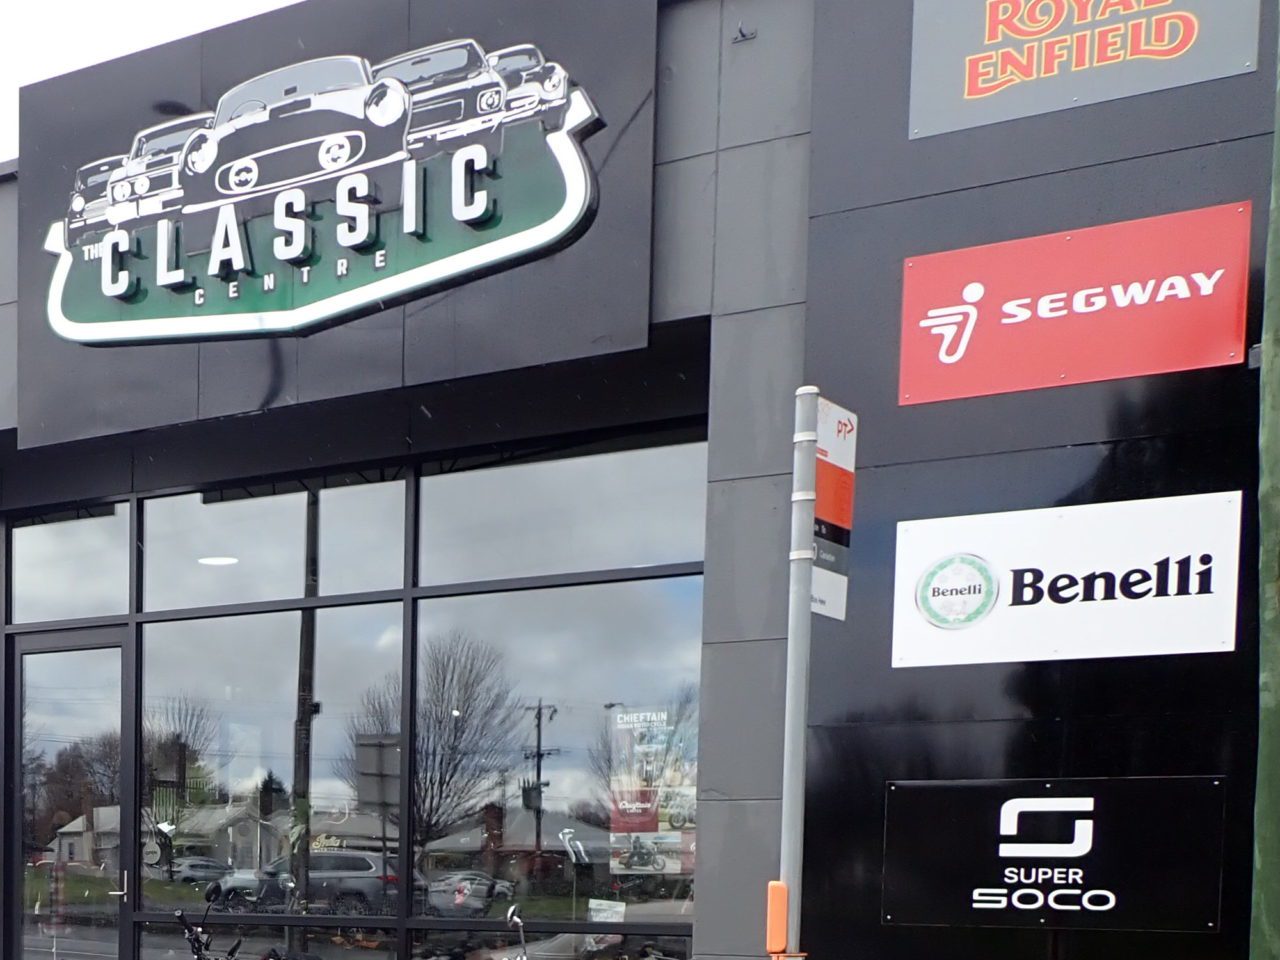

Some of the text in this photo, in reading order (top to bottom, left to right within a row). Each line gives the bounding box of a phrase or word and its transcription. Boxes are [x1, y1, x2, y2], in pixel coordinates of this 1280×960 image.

[964, 11, 1198, 99] ENFIELD
[101, 144, 488, 298] CLASSIC
[194, 249, 386, 306] CENTRE
[1000, 268, 1225, 325] SEGWAY
[931, 584, 983, 598] Benelli
[1007, 553, 1215, 607] Benelli
[616, 711, 668, 724] CHIEFTAIN
[972, 888, 1116, 911] SOCO
[1003, 867, 1084, 884] SUPER
